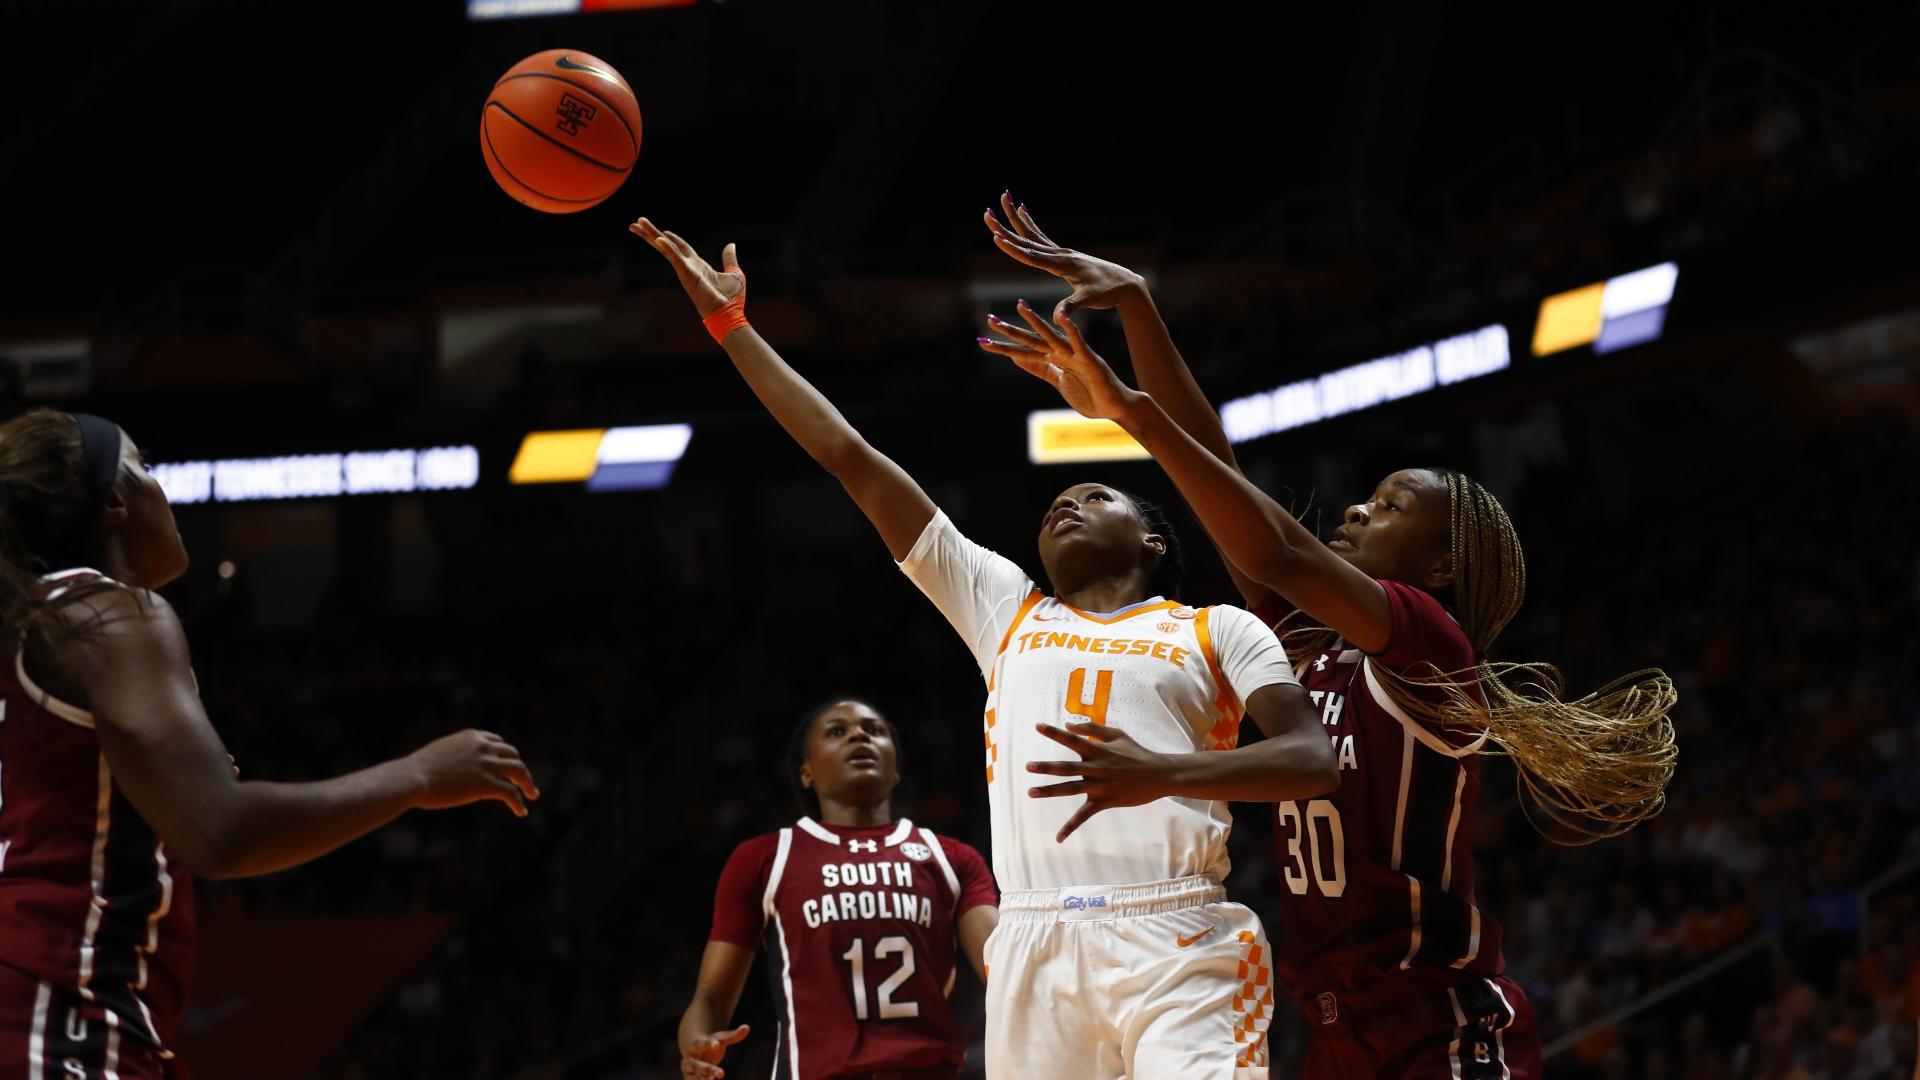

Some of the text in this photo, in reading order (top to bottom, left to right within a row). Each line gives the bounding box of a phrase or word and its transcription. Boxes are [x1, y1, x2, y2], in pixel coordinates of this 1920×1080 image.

[1017, 631, 1191, 668] TENNESSEE
[1064, 667, 1114, 742] 4
[1278, 799, 1347, 897] 30
[821, 861, 913, 888] SOUTH
[802, 890, 932, 929] CAROLINA
[1063, 895, 1107, 911] Lady Vols
[843, 936, 919, 1020] 12
